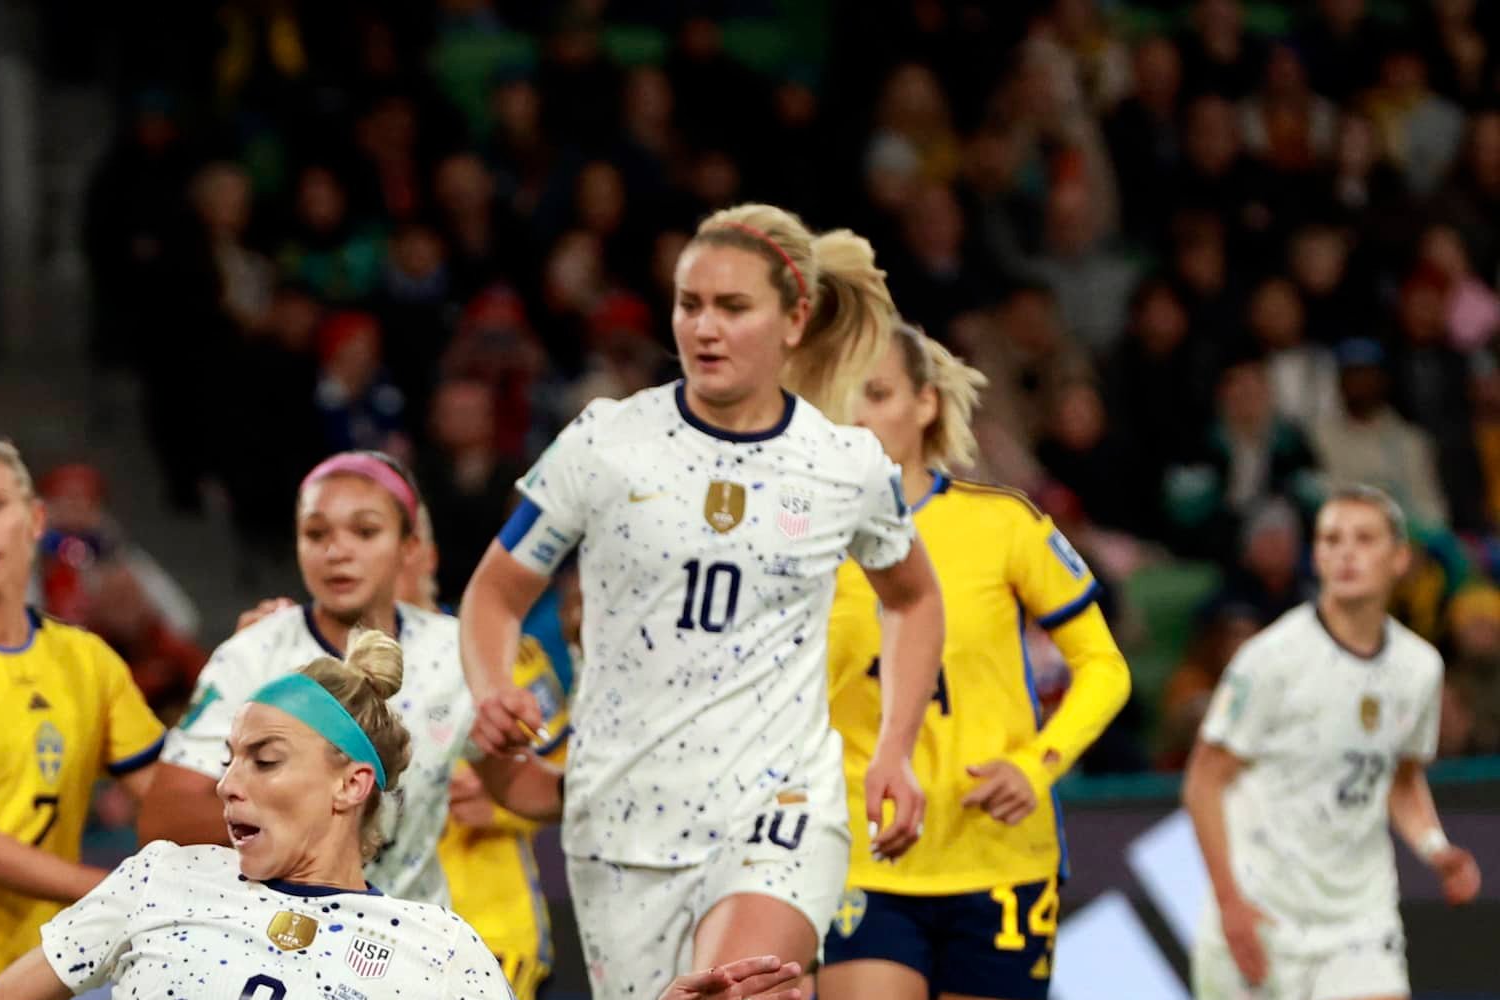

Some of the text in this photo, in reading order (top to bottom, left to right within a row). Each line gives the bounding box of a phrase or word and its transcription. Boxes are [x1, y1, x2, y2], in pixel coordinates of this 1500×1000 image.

[677, 558, 742, 632] 10
[33, 795, 60, 847] 7
[990, 880, 1060, 951] 14
[354, 938, 390, 961] USA
